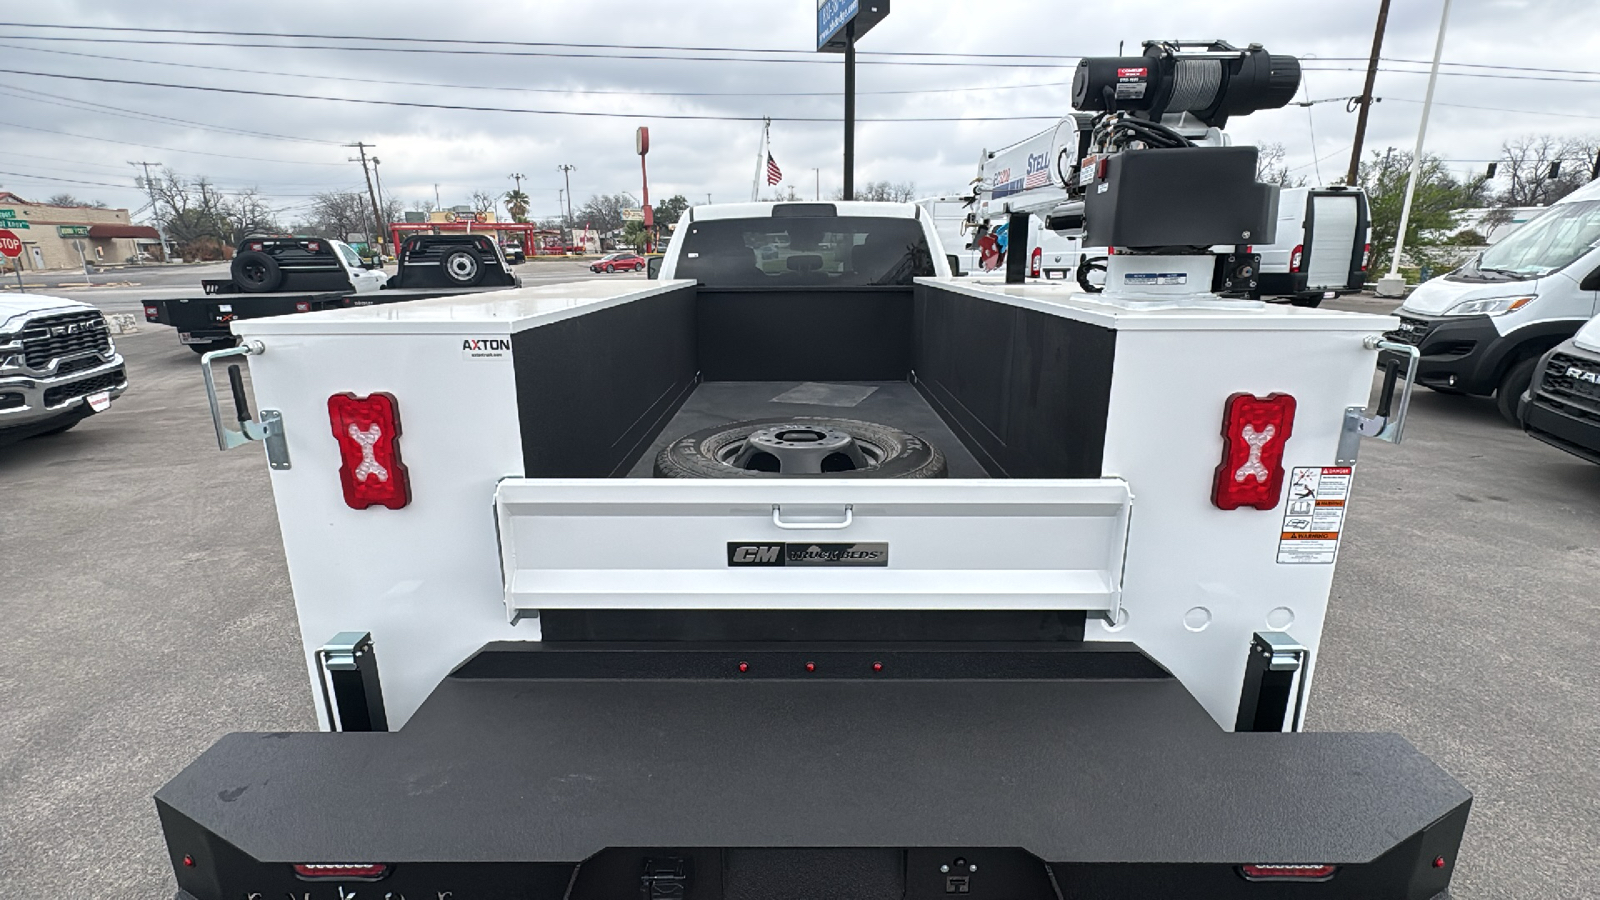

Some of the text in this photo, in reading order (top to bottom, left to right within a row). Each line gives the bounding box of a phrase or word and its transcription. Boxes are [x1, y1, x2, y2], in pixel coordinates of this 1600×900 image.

[1026, 151, 1051, 175] STELL
[462, 339, 511, 351] AXTON
[732, 546, 781, 563] CM
[790, 550, 839, 561] TRUCK
